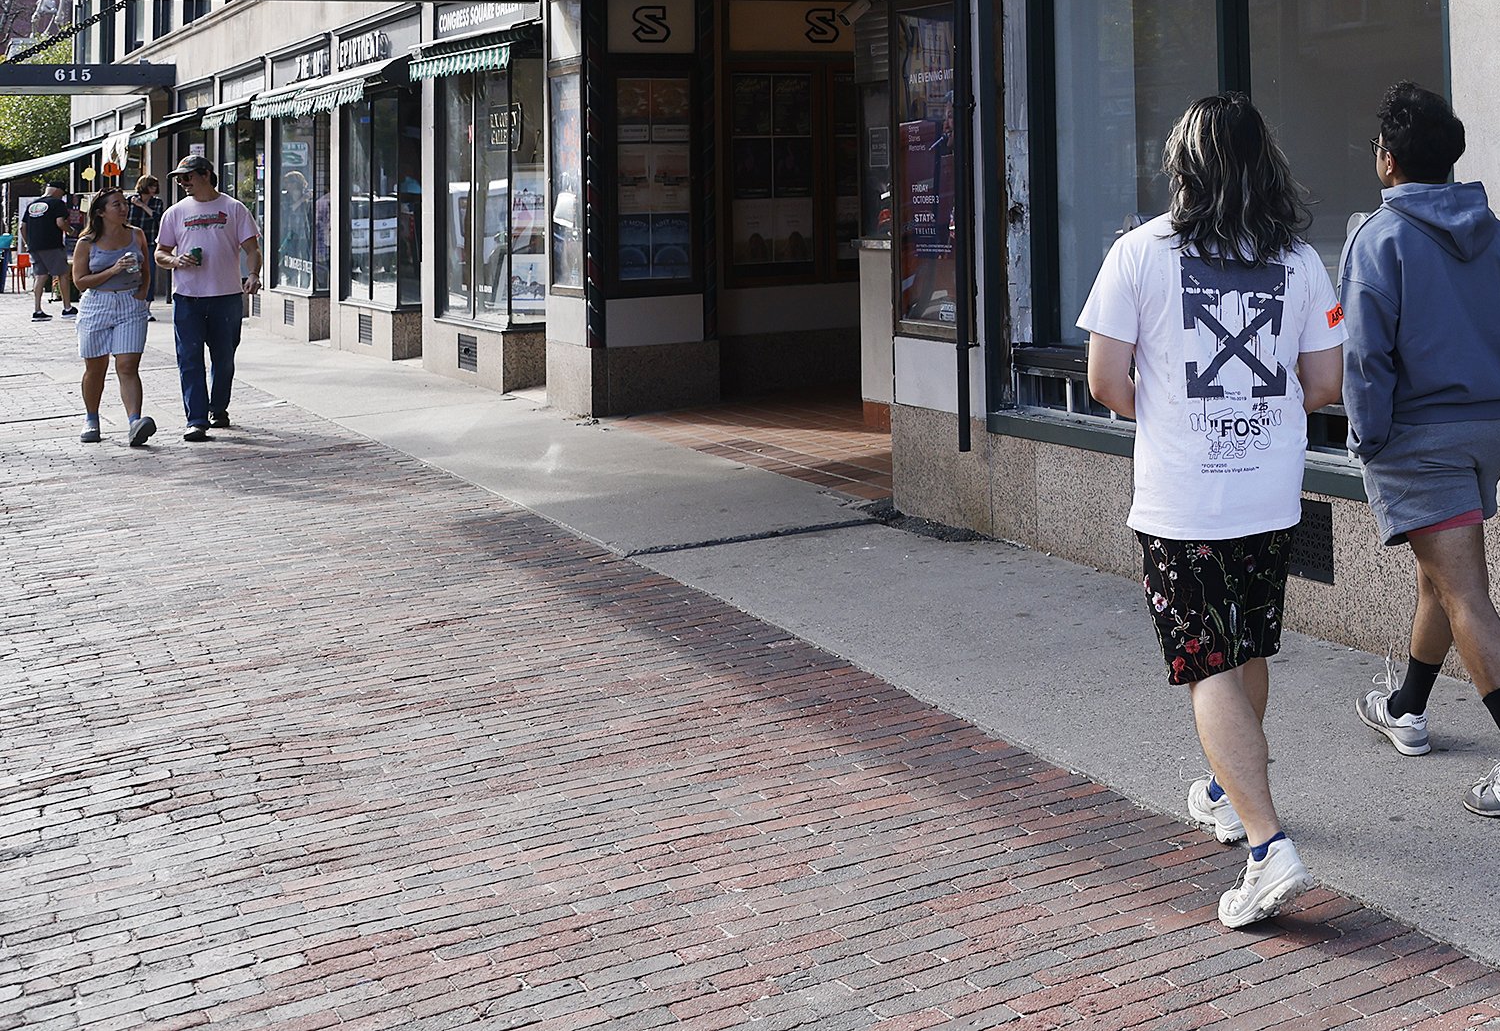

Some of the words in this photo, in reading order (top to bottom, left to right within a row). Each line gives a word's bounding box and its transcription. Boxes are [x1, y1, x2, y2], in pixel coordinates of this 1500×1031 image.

[439, 7, 470, 33] CONGRESS
[470, 3, 495, 26] SQUARE
[340, 30, 380, 67] EPARTMENT
[54, 68, 92, 82] 615
[918, 70, 943, 84] EVENING
[911, 184, 929, 193] FRIDAY
[912, 195, 935, 205] OCTOBER
